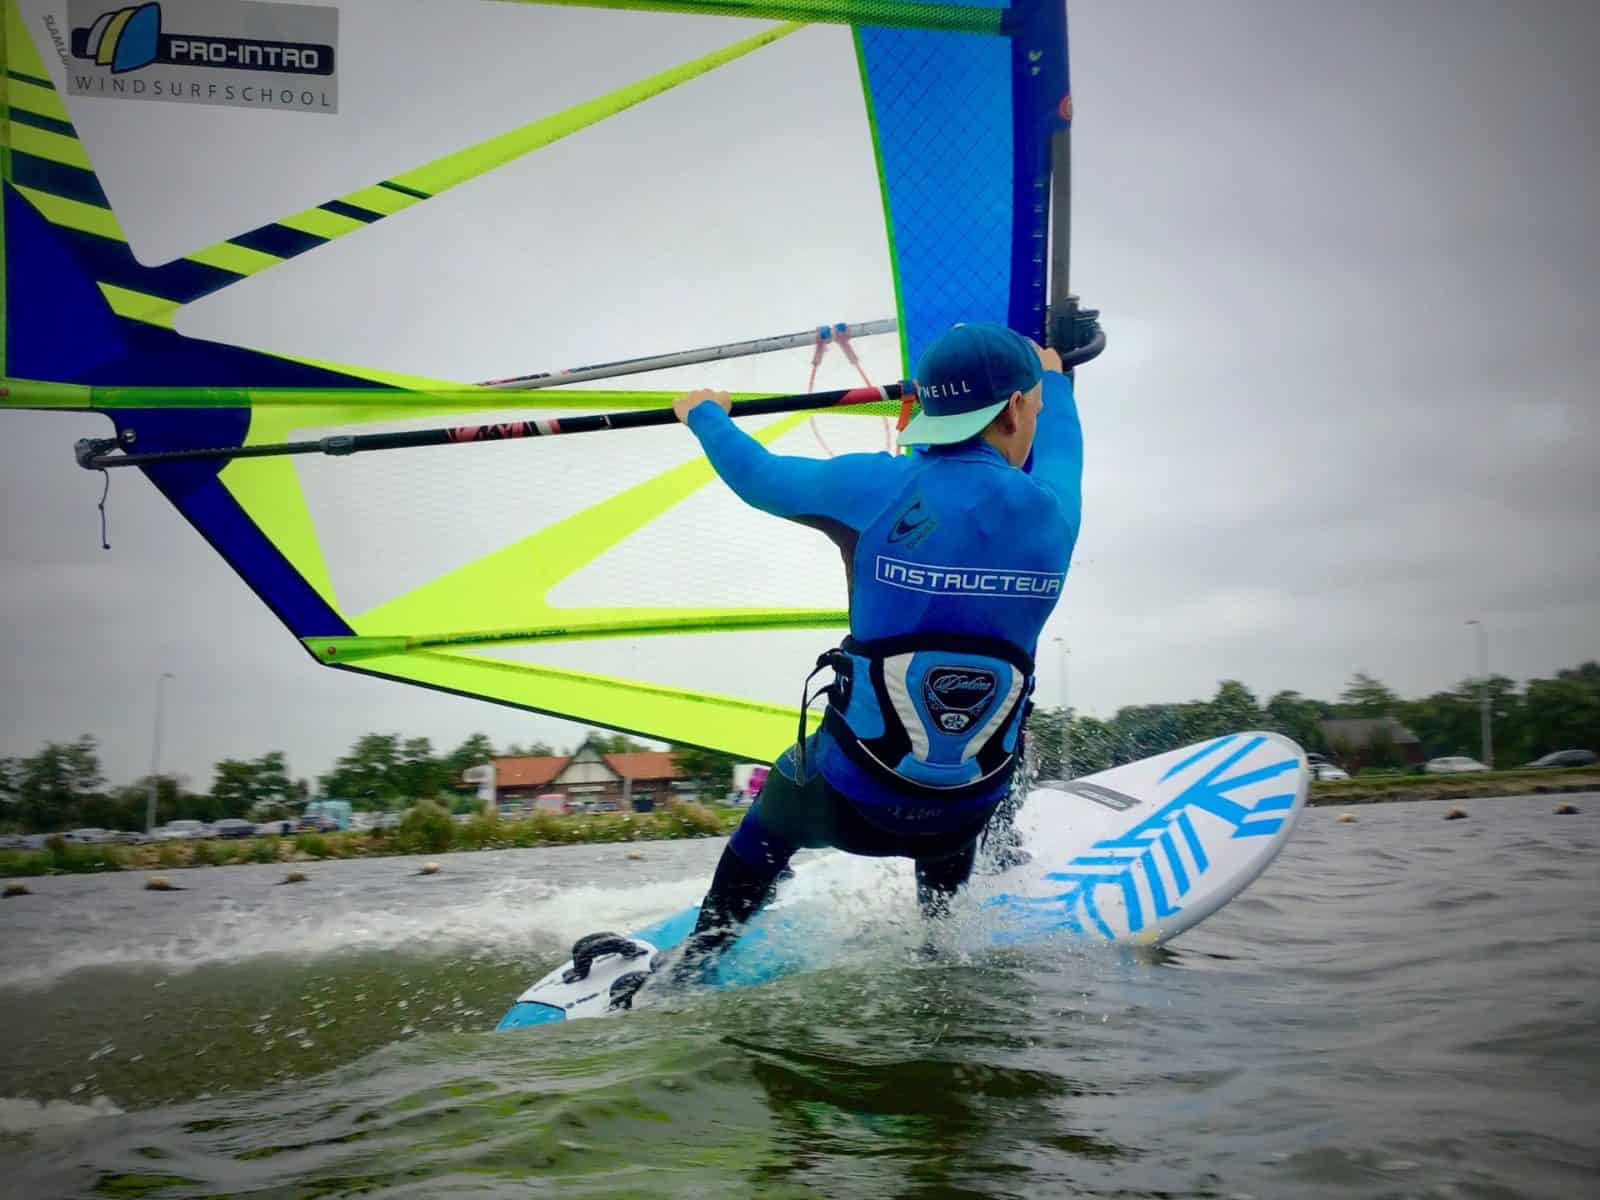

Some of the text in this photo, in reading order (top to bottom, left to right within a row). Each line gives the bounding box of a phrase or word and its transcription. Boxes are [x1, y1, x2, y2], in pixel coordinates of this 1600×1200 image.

[171, 39, 320, 69] PRO-INTRO
[76, 75, 330, 106] WINDSURFSCHOOL
[883, 562, 1061, 594] INSTRUCTEUR
